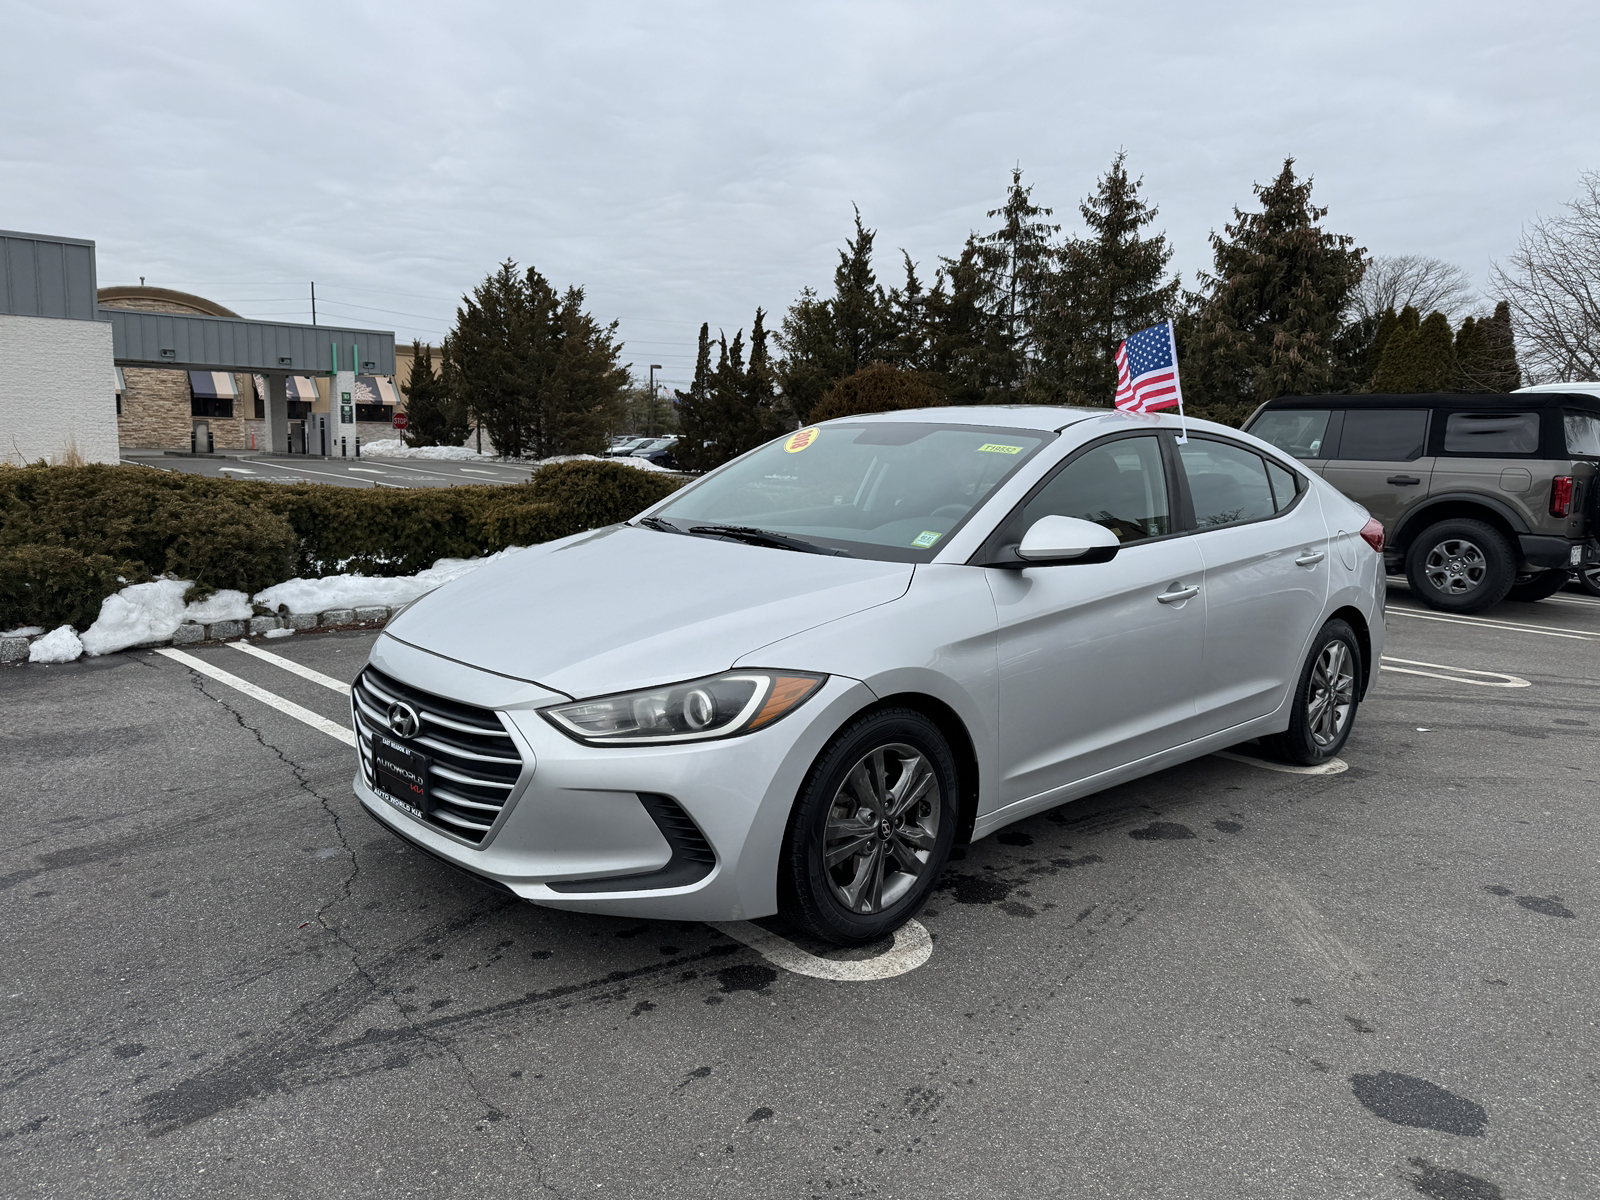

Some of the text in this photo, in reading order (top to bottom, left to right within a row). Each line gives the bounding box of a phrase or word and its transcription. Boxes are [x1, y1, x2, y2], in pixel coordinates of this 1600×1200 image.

[394, 417, 407, 425] STOP
[790, 430, 814, 449] 2018
[376, 757, 424, 785] AUTOWORLD
[374, 788, 422, 818] AUTO WORLD KIA
